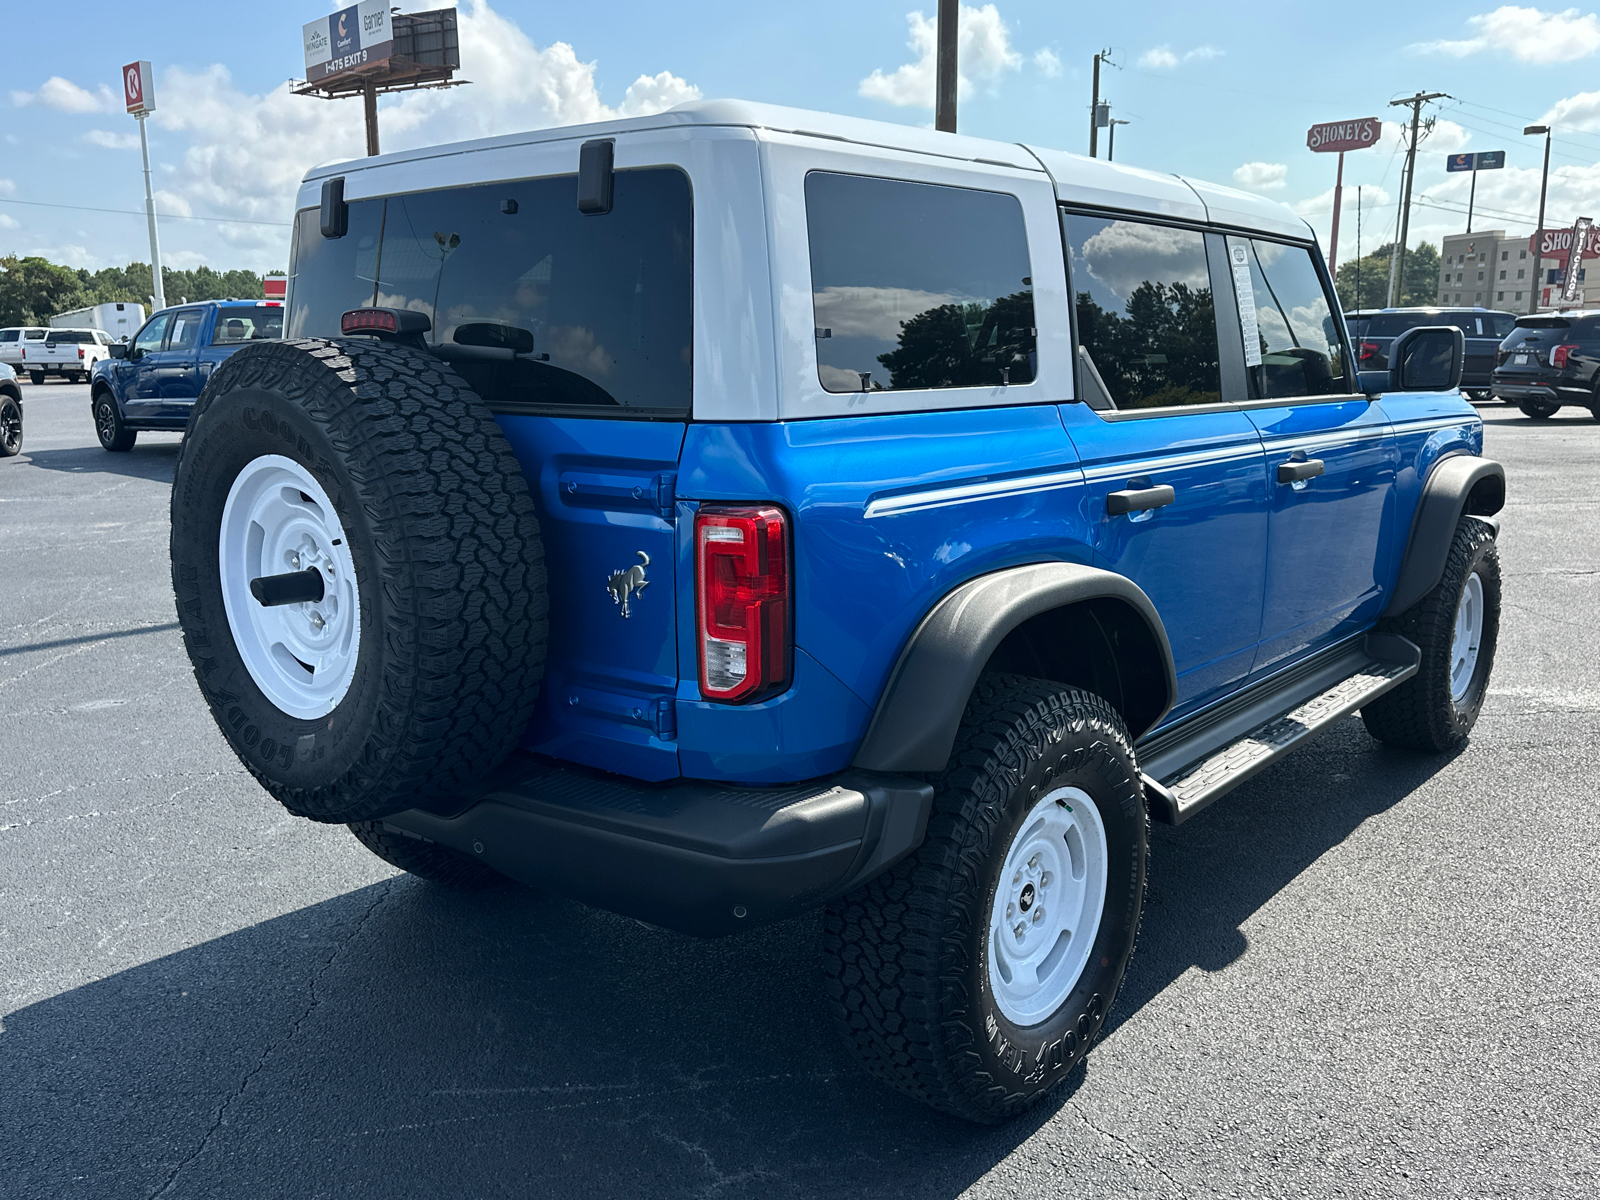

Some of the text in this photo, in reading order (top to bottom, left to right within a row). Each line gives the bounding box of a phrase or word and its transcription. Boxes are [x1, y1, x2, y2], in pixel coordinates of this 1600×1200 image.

[363, 11, 384, 31] Garner
[305, 36, 328, 53] WINGATE
[325, 57, 344, 74] I-475
[344, 52, 362, 68] EXIT
[362, 49, 368, 62] 9
[1309, 120, 1374, 148] SHONEY'S
[1541, 232, 1600, 254] SHOY'S
[1576, 231, 1586, 254] OIL
[179, 563, 294, 771] GOODYEAR
[1024, 739, 1138, 821] GOODYEAR
[985, 992, 1103, 1085] GOODYEAR
